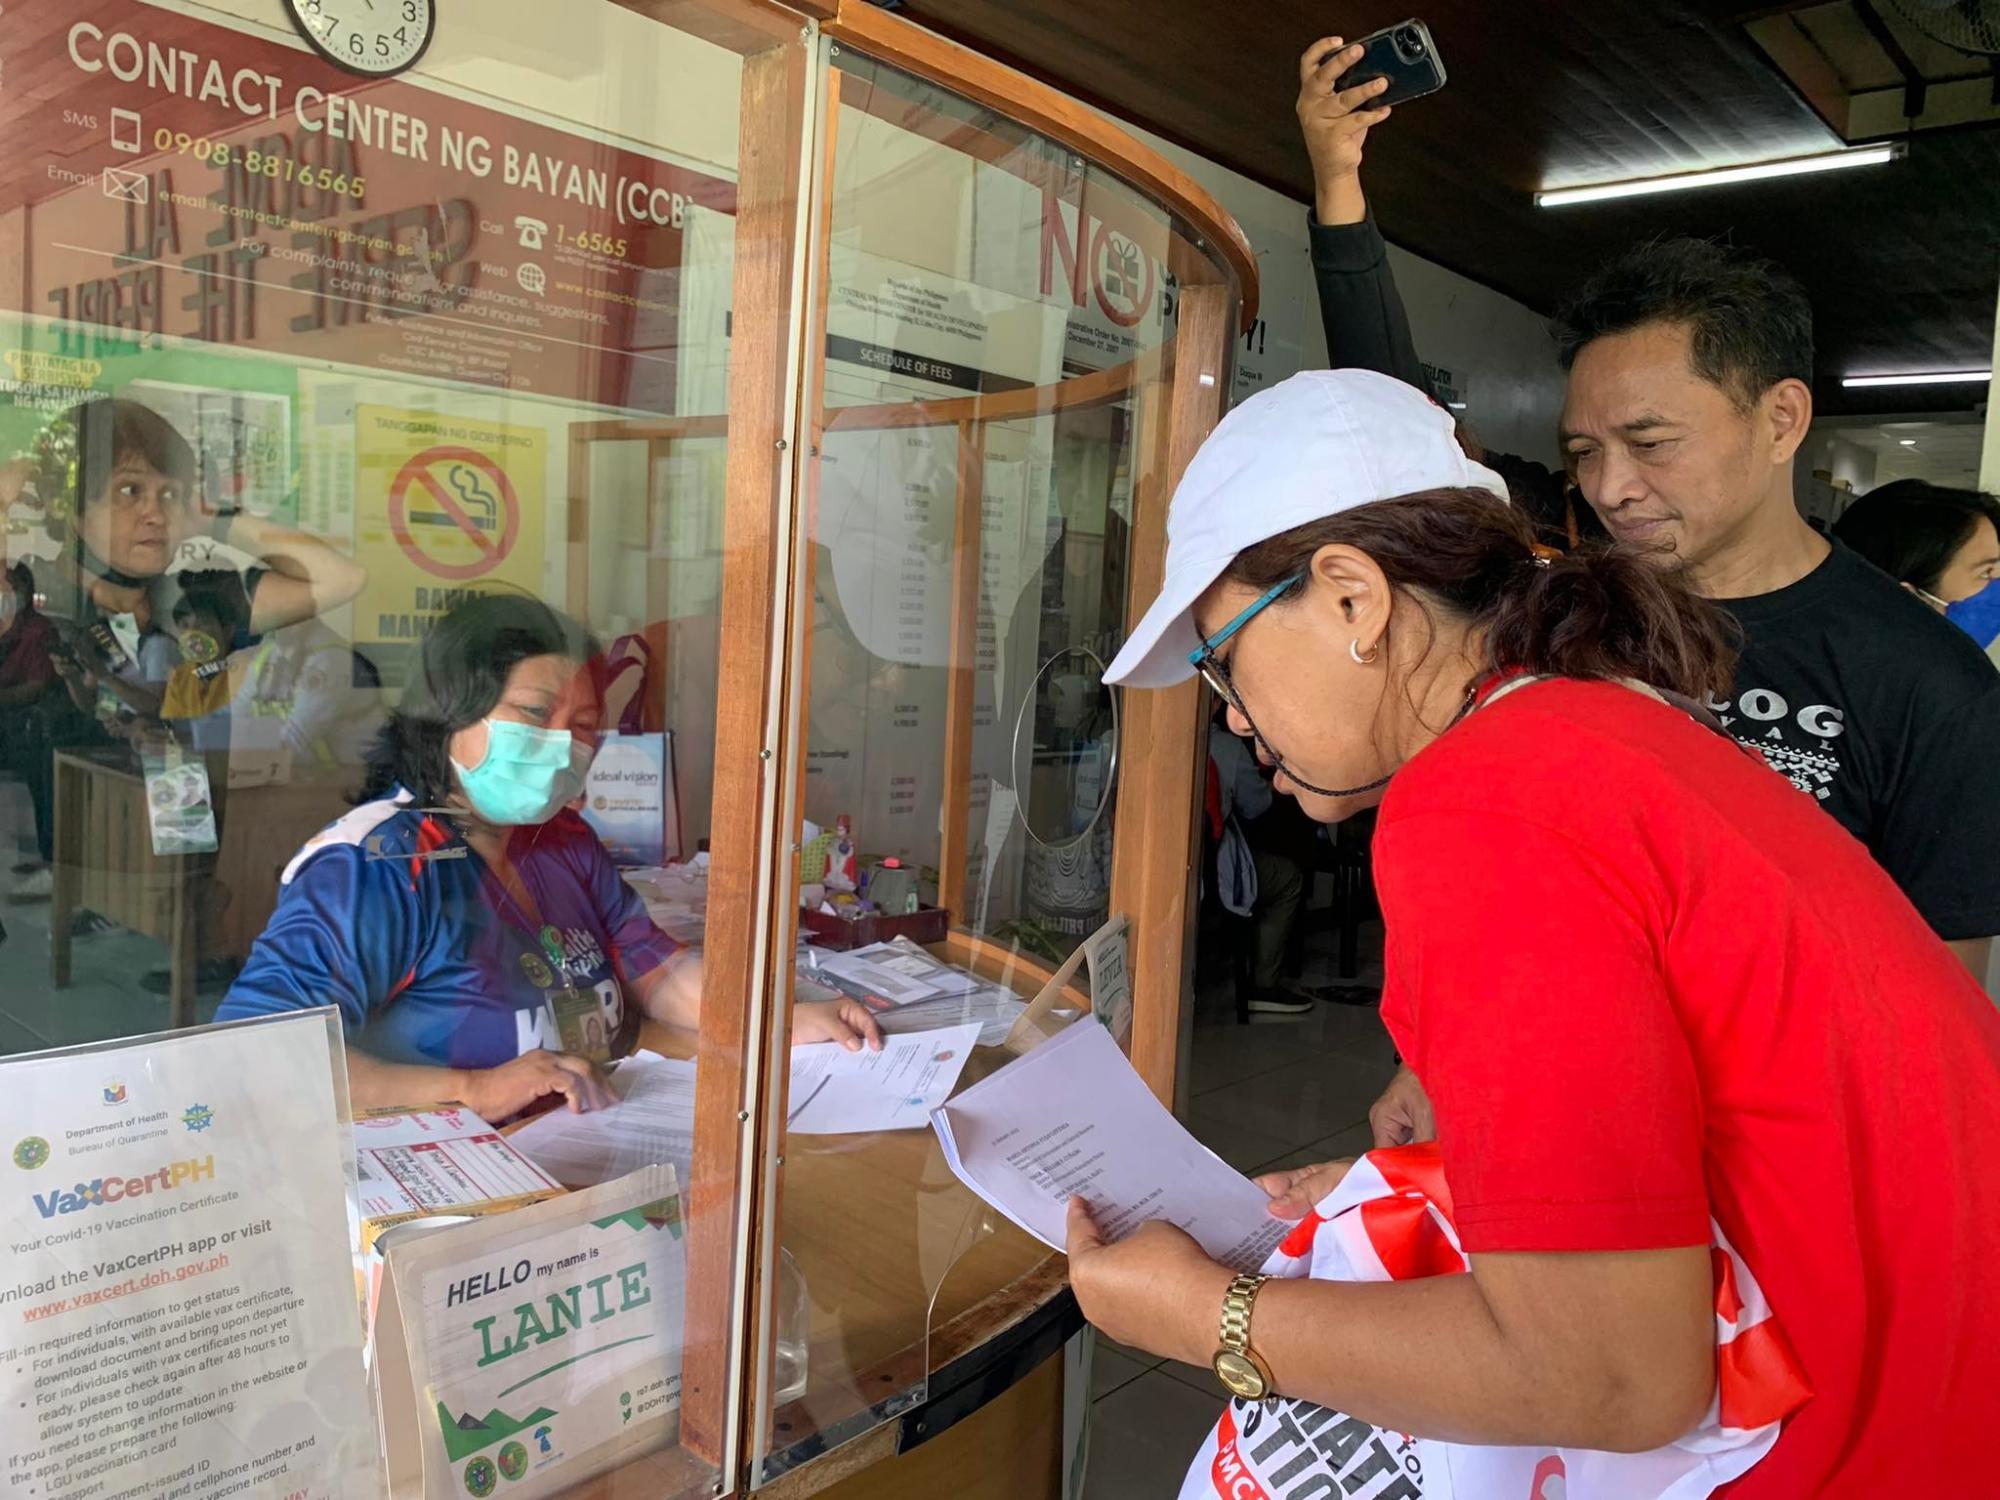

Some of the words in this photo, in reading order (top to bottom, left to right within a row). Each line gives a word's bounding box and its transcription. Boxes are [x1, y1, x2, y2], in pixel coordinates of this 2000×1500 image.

[324, 15, 339, 37] 7
[393, 26, 407, 46] 4
[402, 1, 416, 22] 3
[349, 33, 364, 55] 6
[375, 34, 390, 56] 5
[63, 110, 98, 129] SMS
[68, 22, 282, 120] CONTACT
[295, 86, 428, 161] CENTER
[441, 127, 492, 177] NG
[504, 145, 607, 208] BAYAN
[47, 165, 95, 187] Email
[154, 128, 366, 198] 0908-8816565
[240, 237, 266, 254] For
[556, 224, 628, 257] 1-6565
[480, 260, 509, 278] Web
[458, 301, 487, 318] and
[860, 347, 913, 371] SCHEDULE
[914, 360, 929, 375] OF
[930, 363, 953, 381] FEES
[624, 770, 659, 784] vision
[66, 1120, 124, 1139] Department
[125, 1117, 135, 1127] of
[138, 1111, 168, 1124] Health
[69, 1141, 104, 1156] Bureau
[105, 1139, 116, 1149] of
[117, 1128, 168, 1146] Quarantine
[32, 1155, 215, 1219] VaxCertPH
[11, 1240, 41, 1255] Your
[45, 1224, 102, 1246] Covid-19
[106, 1207, 177, 1232] Vaccination
[179, 1190, 239, 1214] Certificate
[61, 1267, 89, 1287] the
[93, 1243, 184, 1277] VaxCertPH
[188, 1237, 217, 1255] app
[221, 1230, 236, 1243] or
[240, 1219, 272, 1239] visit
[446, 1258, 531, 1308] HELLO
[537, 1264, 555, 1278] my
[557, 1253, 587, 1272] name
[589, 1247, 600, 1260] is
[23, 1253, 229, 1322] www.vaxcert.doh.gov.ph
[472, 1262, 652, 1368] LANIE
[32, 1357, 54, 1372] For
[57, 1334, 129, 1365] individuals,
[131, 1325, 156, 1342] with
[159, 1310, 211, 1334] available
[214, 1303, 233, 1316] vax
[235, 1286, 294, 1310] certificate,
[34, 1362, 97, 1389] download
[100, 1341, 162, 1367] document
[165, 1333, 187, 1349] and
[190, 1323, 219, 1344] bring
[222, 1315, 250, 1334] upon
[252, 1296, 305, 1322] departure
[39, 1327, 93, 1354] required
[94, 1306, 166, 1334] information
[169, 1301, 181, 1315] to
[183, 1296, 202, 1311] get
[205, 1285, 240, 1303] status
[36, 1391, 57, 1407] For
[60, 1369, 129, 1399] individuals
[132, 1359, 157, 1376] with
[160, 1354, 181, 1368] vax
[183, 1331, 247, 1360] certificates
[250, 1322, 267, 1336] not
[270, 1318, 288, 1334] yet
[38, 1406, 77, 1424] ready,
[80, 1388, 121, 1413] please
[124, 1377, 160, 1398] check
[163, 1364, 196, 1384] again
[198, 1354, 224, 1373] after
[226, 1346, 242, 1360] 48
[243, 1338, 272, 1356] hours
[275, 1333, 290, 1346] to
[8, 1456, 19, 1469] If
[22, 1448, 46, 1466] you
[49, 1436, 80, 1455] need
[84, 1429, 96, 1442] to
[99, 1415, 145, 1438] change
[148, 1390, 216, 1421] information
[219, 1386, 229, 1398] in
[231, 1377, 250, 1394] the
[253, 1365, 295, 1388] website
[298, 1359, 308, 1371] or
[39, 1422, 74, 1441] allow
[77, 1407, 124, 1429] system
[127, 1399, 139, 1411] to
[142, 1384, 184, 1408] update
[11, 1470, 32, 1486] the
[36, 1462, 63, 1478] app,
[65, 1445, 107, 1469] please
[110, 1428, 157, 1454] prepare
[160, 1421, 179, 1436] the
[45, 1474, 73, 1492] LGU
[75, 1449, 148, 1481] vaccination
[150, 1437, 177, 1455] card
[169, 1485, 191, 1499] and
[193, 1468, 249, 1492] cellphone
[251, 1451, 292, 1470] number
[295, 1436, 316, 1454] and
[198, 1459, 210, 1474] ID
[207, 1480, 250, 1499] vaccine
